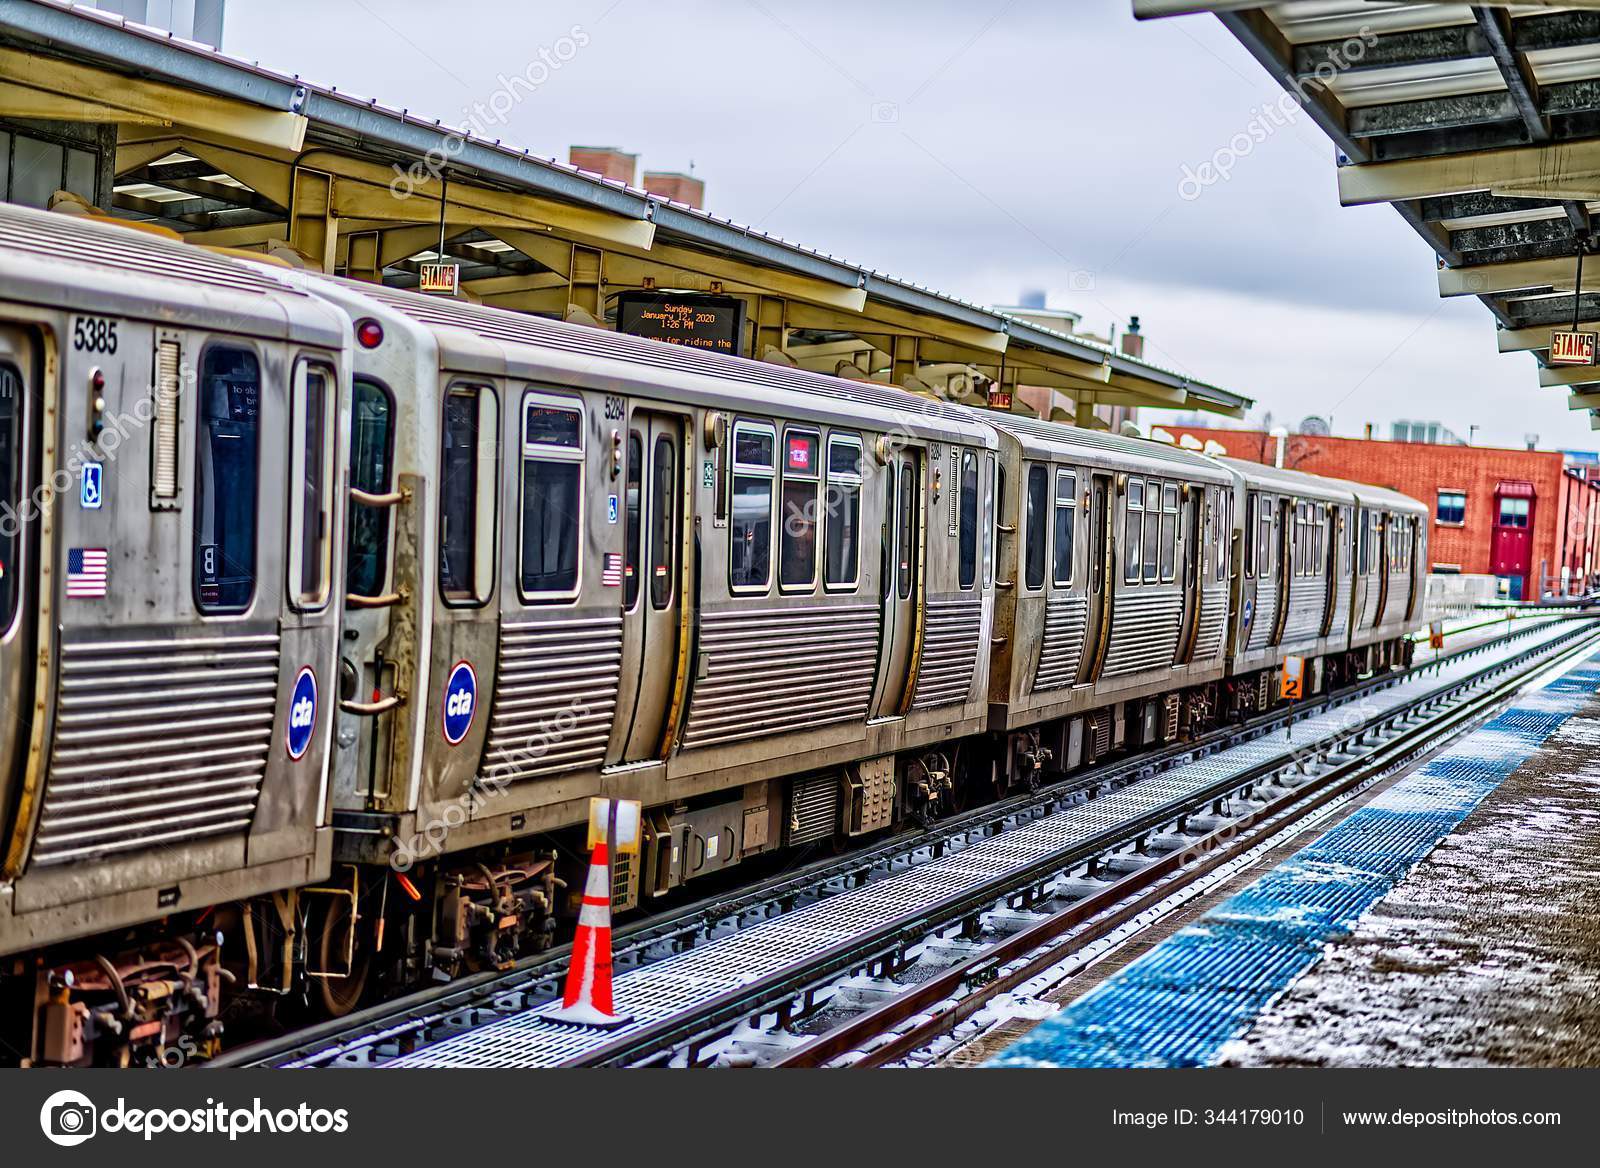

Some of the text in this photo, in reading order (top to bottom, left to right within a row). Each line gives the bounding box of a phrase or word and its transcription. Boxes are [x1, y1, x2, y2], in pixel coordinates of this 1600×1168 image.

[421, 266, 454, 286] STAIRS
[641, 311, 674, 320] January
[696, 313, 715, 323] 2020
[664, 303, 693, 313] Sunday
[661, 320, 694, 330] 1:26 PM
[74, 316, 118, 355] 5385
[717, 339, 732, 348] the
[1553, 333, 1593, 357] STAIRS
[605, 395, 625, 421] 5284
[1285, 679, 1298, 697] 2
[291, 696, 313, 728] cta
[447, 688, 472, 717] cta
